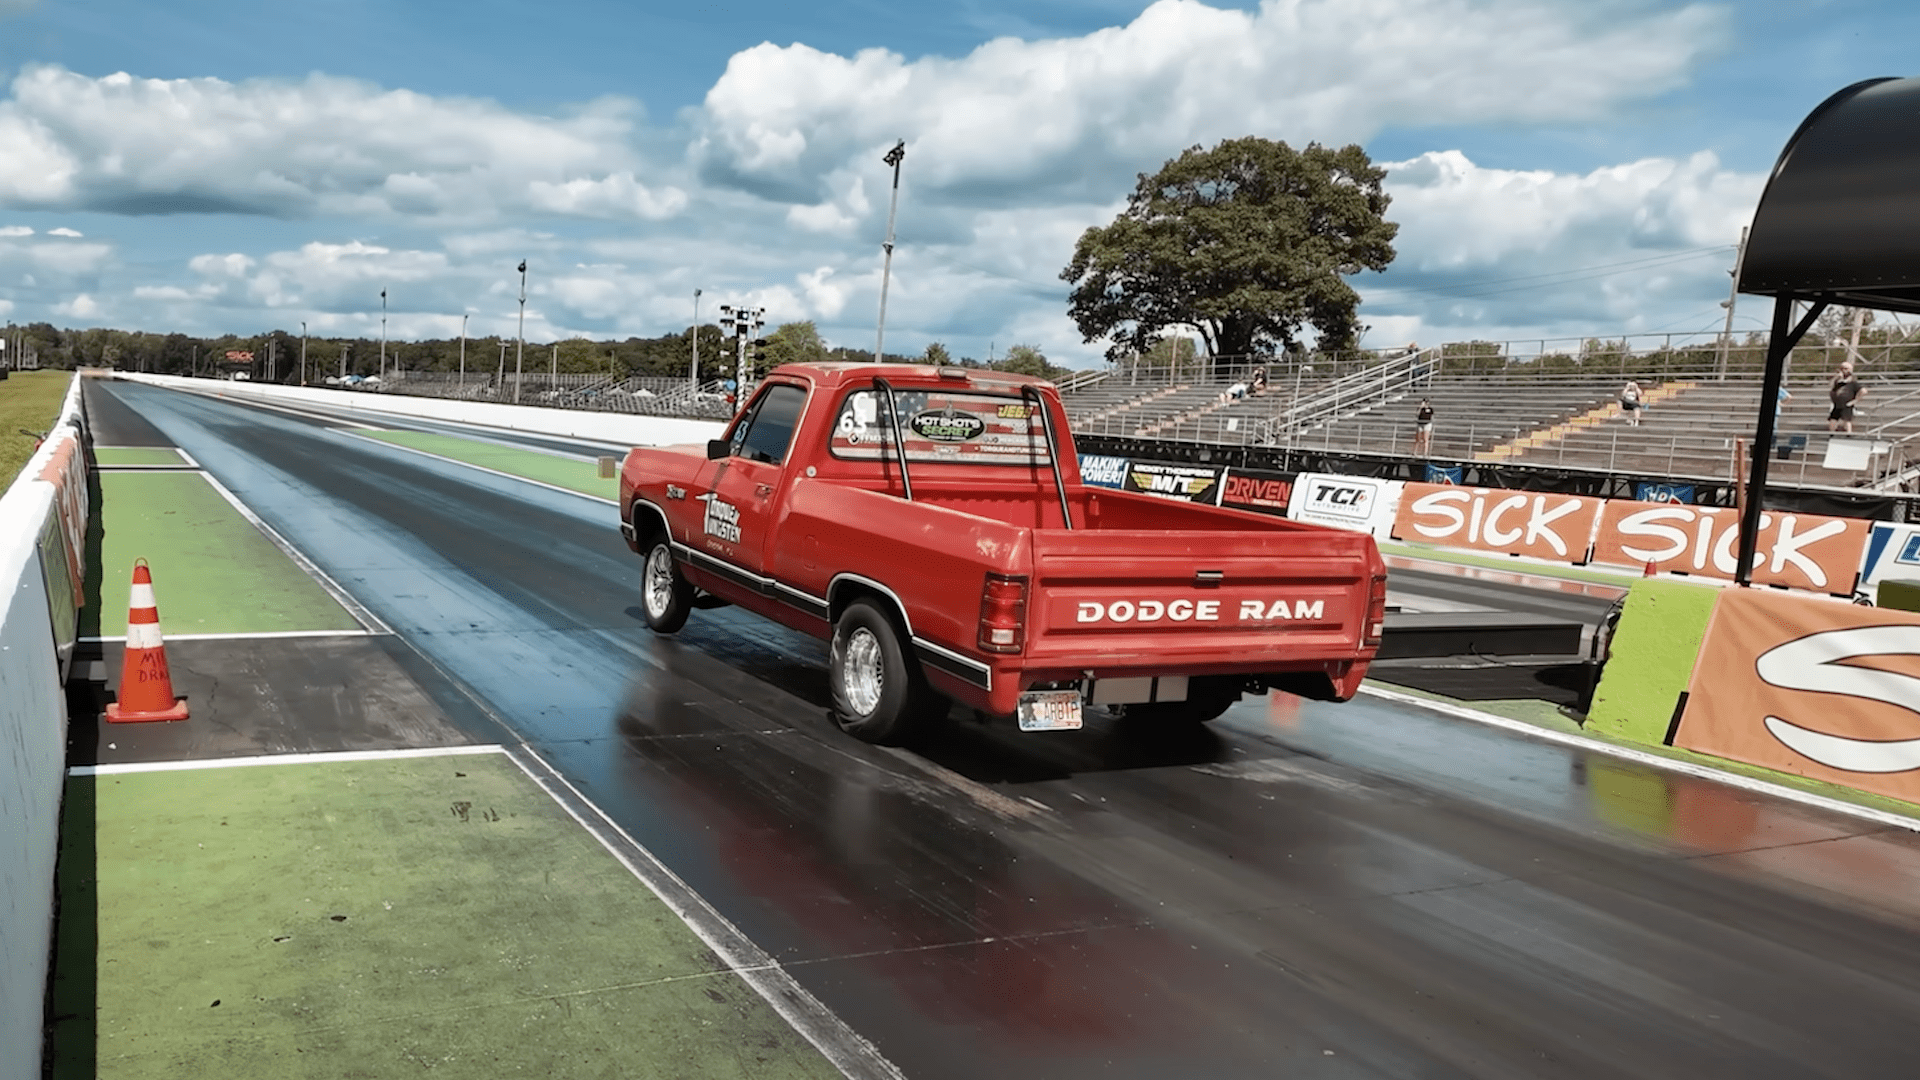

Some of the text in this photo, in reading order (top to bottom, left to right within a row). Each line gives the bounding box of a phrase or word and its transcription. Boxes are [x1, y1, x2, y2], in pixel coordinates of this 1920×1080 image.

[914, 416, 939, 427] HOT
[921, 425, 973, 437] SECRET
[1081, 456, 1126, 471] MAKIN'
[1134, 464, 1216, 477] MICKEY THOMPSON
[1080, 468, 1123, 484] POWER!
[1150, 474, 1195, 493] M/T
[1225, 476, 1292, 503] DRIVEN
[1315, 485, 1363, 507] TCI
[1077, 599, 1325, 623] DODGE RAM
